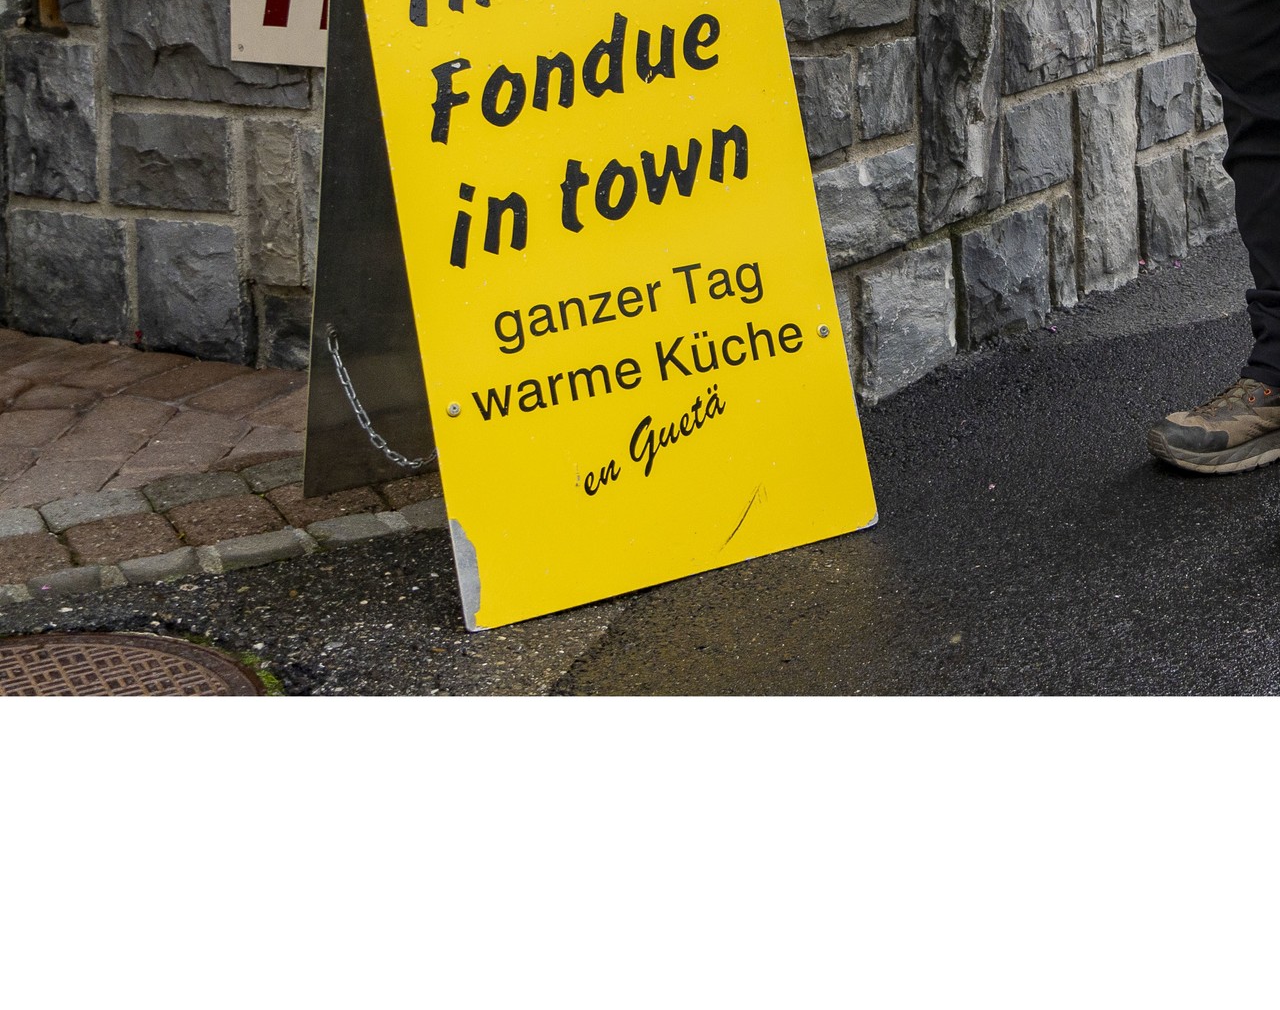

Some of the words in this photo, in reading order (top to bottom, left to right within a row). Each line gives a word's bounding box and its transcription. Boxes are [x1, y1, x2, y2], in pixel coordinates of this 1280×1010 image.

[430, 12, 721, 144] Fondue
[449, 182, 528, 269] in
[560, 124, 749, 233] town
[494, 275, 661, 355] ganzer
[672, 258, 764, 305] Tag
[472, 358, 642, 422] warme
[656, 316, 805, 390] Küche
[583, 457, 621, 498] en
[627, 382, 727, 478] Guetä
